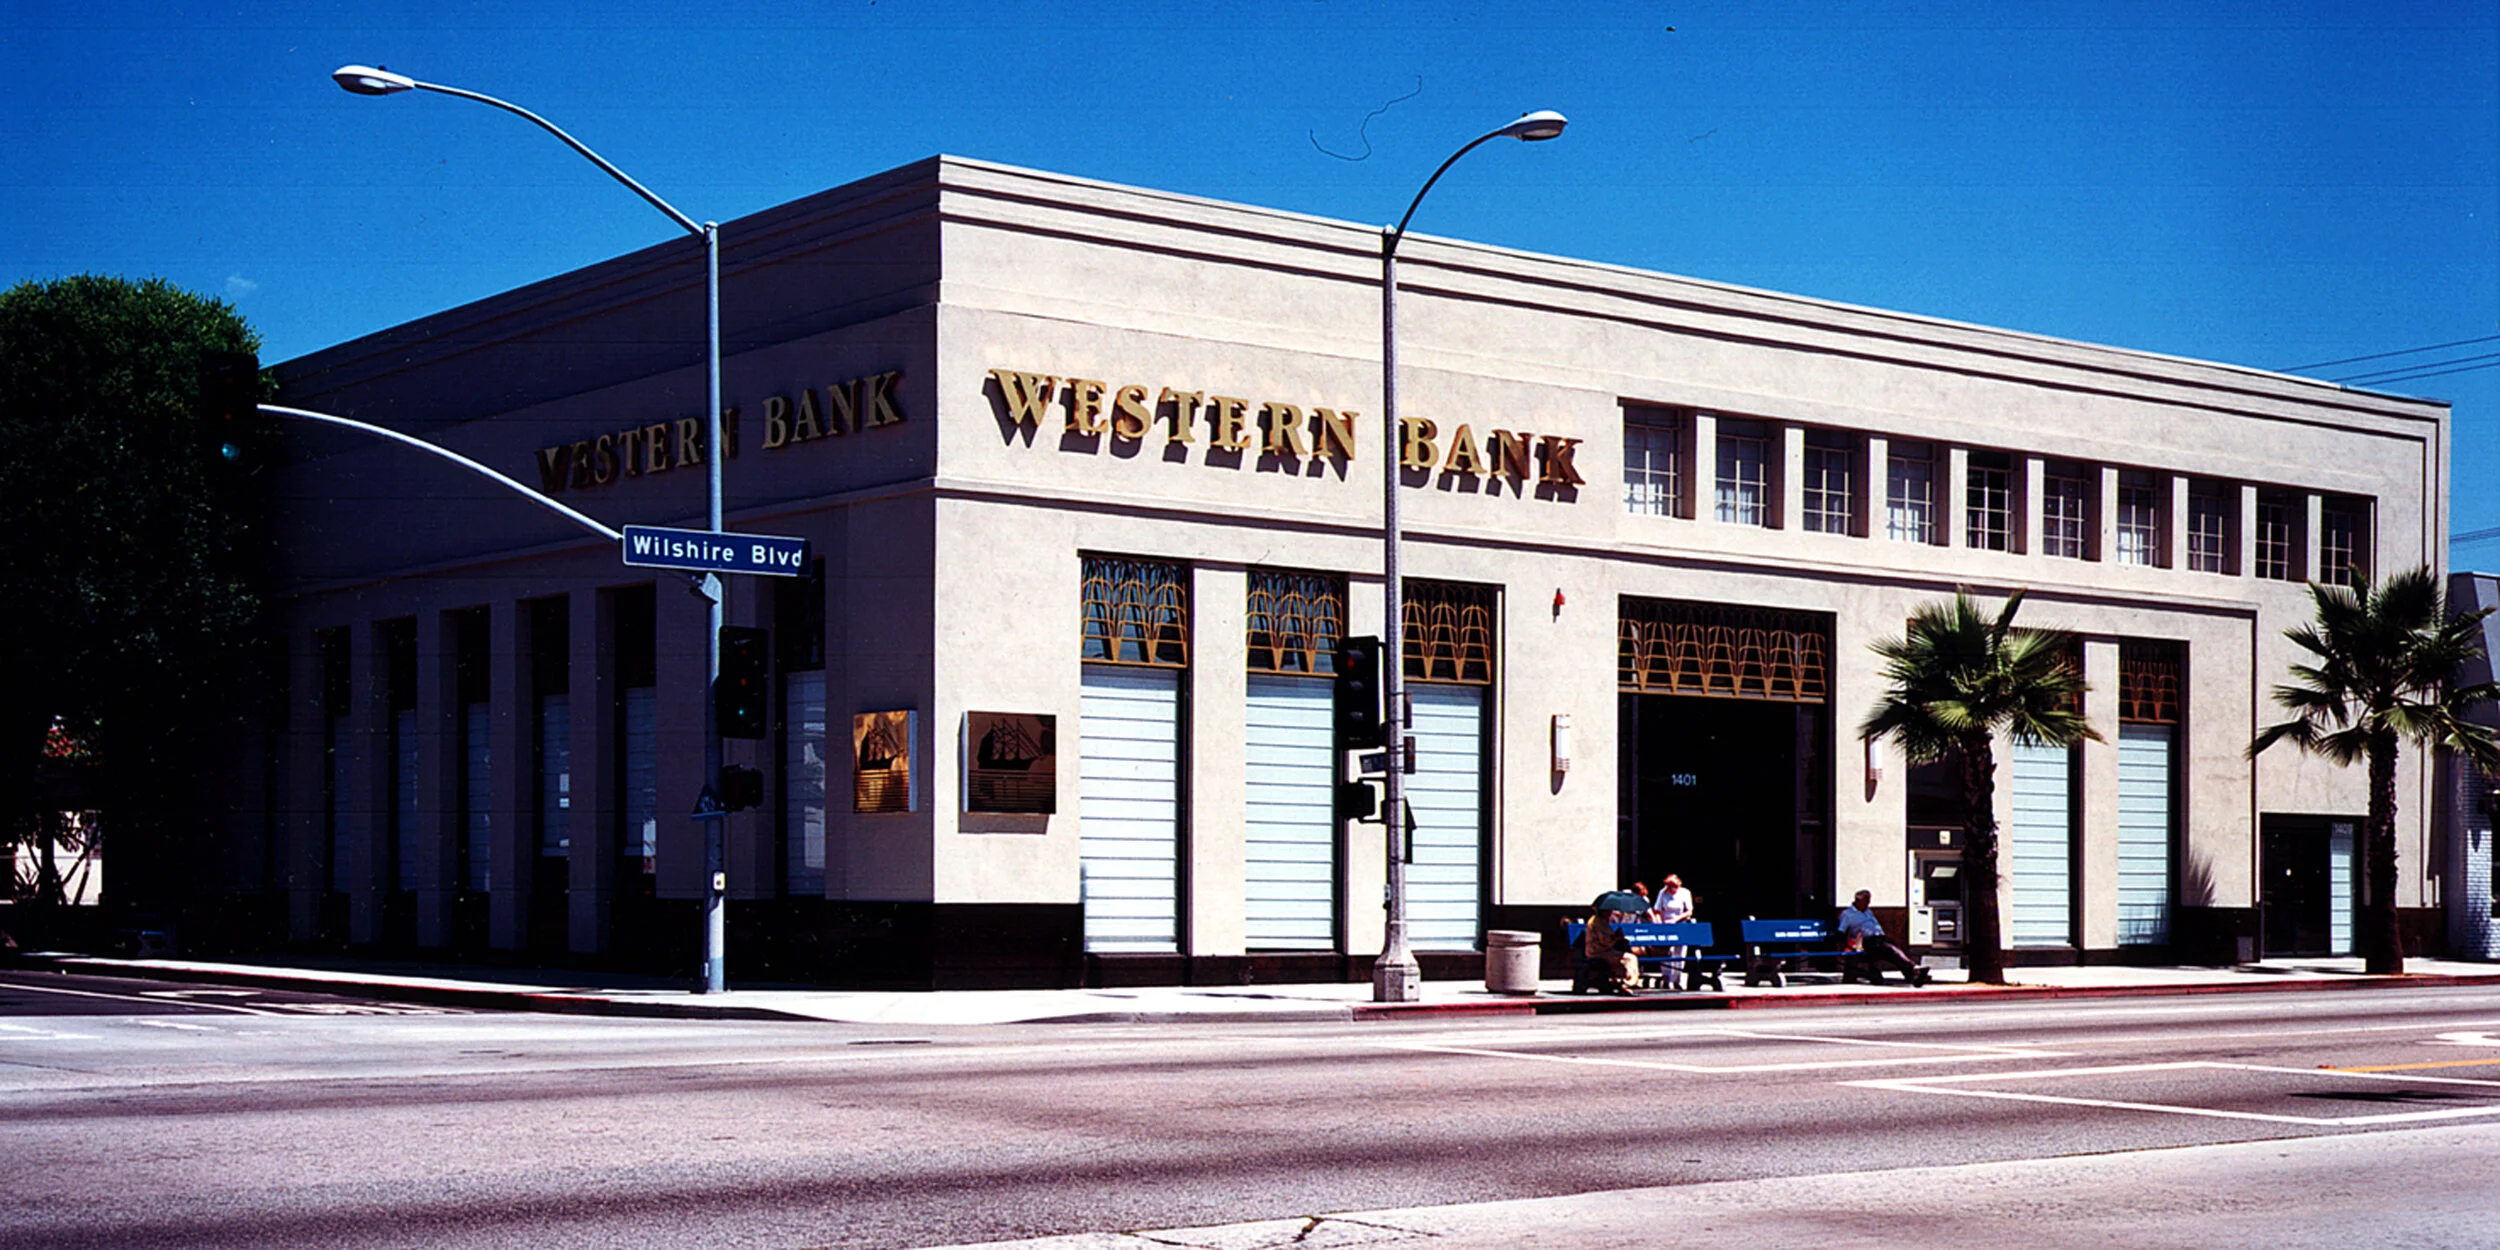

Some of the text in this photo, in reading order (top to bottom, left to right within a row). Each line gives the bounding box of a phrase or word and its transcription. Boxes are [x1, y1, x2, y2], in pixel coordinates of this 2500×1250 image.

[535, 370, 902, 492] WESTERN BANK
[987, 369, 1586, 487] WESTERN BANK
[633, 535, 802, 567] Wilshire Blvd
[1671, 773, 1697, 786] 1401
